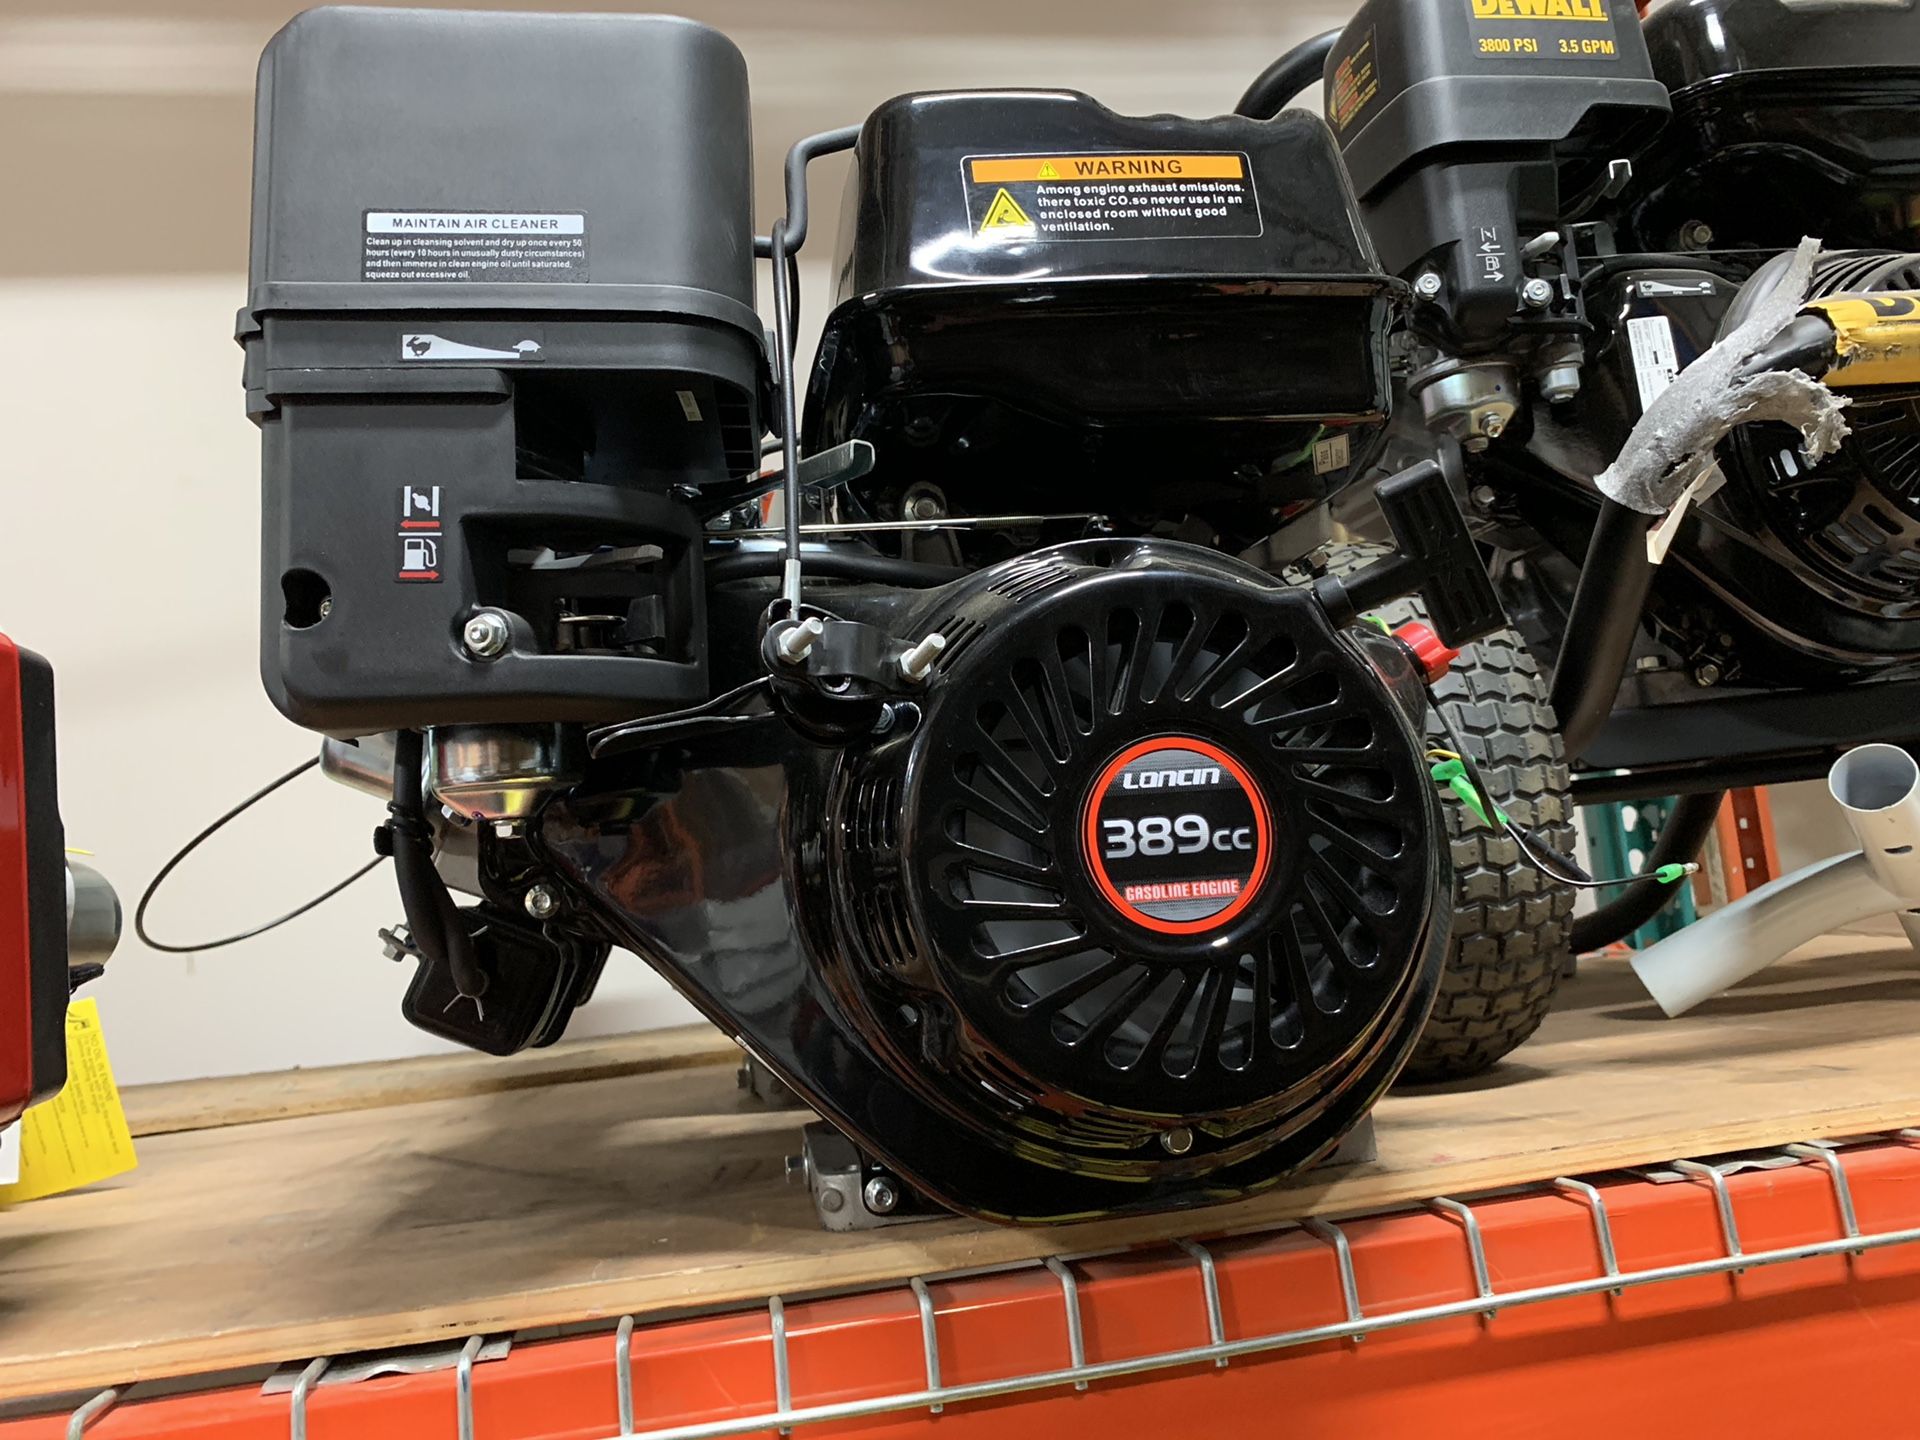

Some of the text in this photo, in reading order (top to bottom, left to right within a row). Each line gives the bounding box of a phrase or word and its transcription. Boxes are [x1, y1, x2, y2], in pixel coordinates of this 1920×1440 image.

[1478, 38, 1615, 54] 3800 PSI 3.5 GPM
[1074, 160, 1182, 175] WARNING
[1037, 184, 1081, 196] Among
[1083, 184, 1126, 196] engine
[1128, 183, 1178, 193] exhaust
[1038, 197, 1071, 207] there
[1073, 196, 1106, 206] toxic
[1150, 196, 1185, 204] never
[1188, 195, 1211, 204] use
[1213, 194, 1225, 203] in
[1227, 195, 1242, 204] an
[1040, 206, 1227, 219] enclosed room without good
[392, 218, 559, 229] MAINTAIN AIR CLEANER
[1041, 221, 1114, 232] ventilation.
[366, 237, 390, 246] Clean
[391, 239, 402, 247] up
[403, 238, 412, 246] in
[413, 238, 453, 248] cleansing
[454, 238, 484, 246] solvent
[485, 238, 500, 246] and
[501, 239, 515, 248] dry
[549, 240, 572, 248] every
[573, 239, 582, 247] 50
[366, 248, 390, 257] hours
[390, 249, 416, 259] (every
[427, 249, 451, 257] hours
[452, 249, 460, 257] in
[461, 249, 500, 259] unusually
[501, 249, 524, 259] dusty
[524, 250, 585, 259] circumstances)
[366, 260, 381, 268] and
[402, 260, 438, 268] immerse
[471, 260, 499, 270] engine
[500, 260, 511, 268] oil
[512, 260, 531, 268] until
[365, 271, 400, 280] squeeze
[416, 271, 457, 279] excessive
[1103, 814, 1252, 859] 389cc
[1125, 879, 1240, 901] GASOLINE ENGINE
